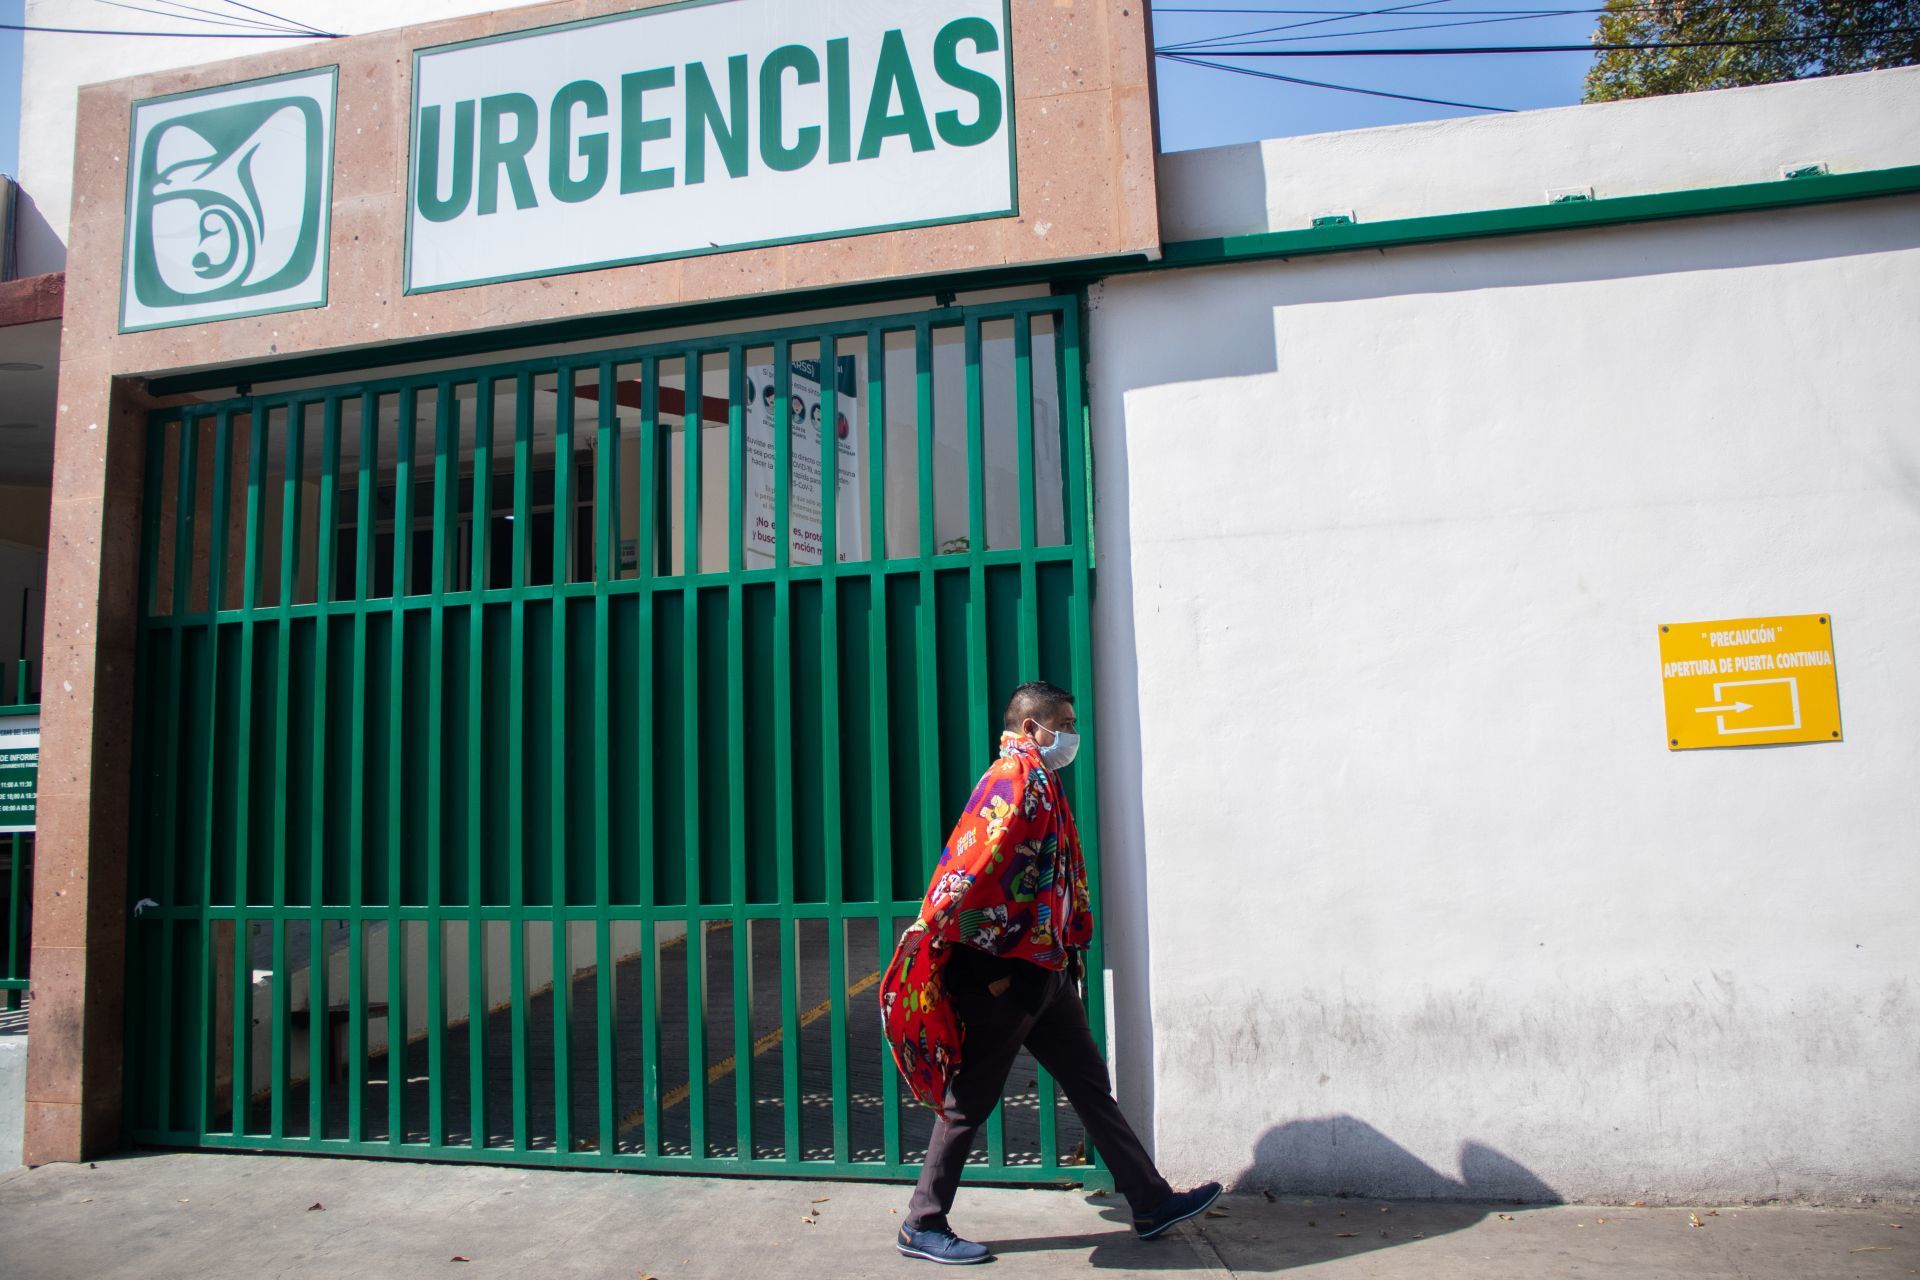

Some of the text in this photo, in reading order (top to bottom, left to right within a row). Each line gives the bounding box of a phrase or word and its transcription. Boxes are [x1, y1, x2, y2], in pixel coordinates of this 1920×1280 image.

[417, 17, 1002, 222] URGENCIAS
[793, 461, 814, 474] OVID-19,
[757, 532, 775, 544] busc
[1664, 650, 1831, 678] APERTURA DE PUERTA CONTINUA
[10, 753, 39, 761] INFORME
